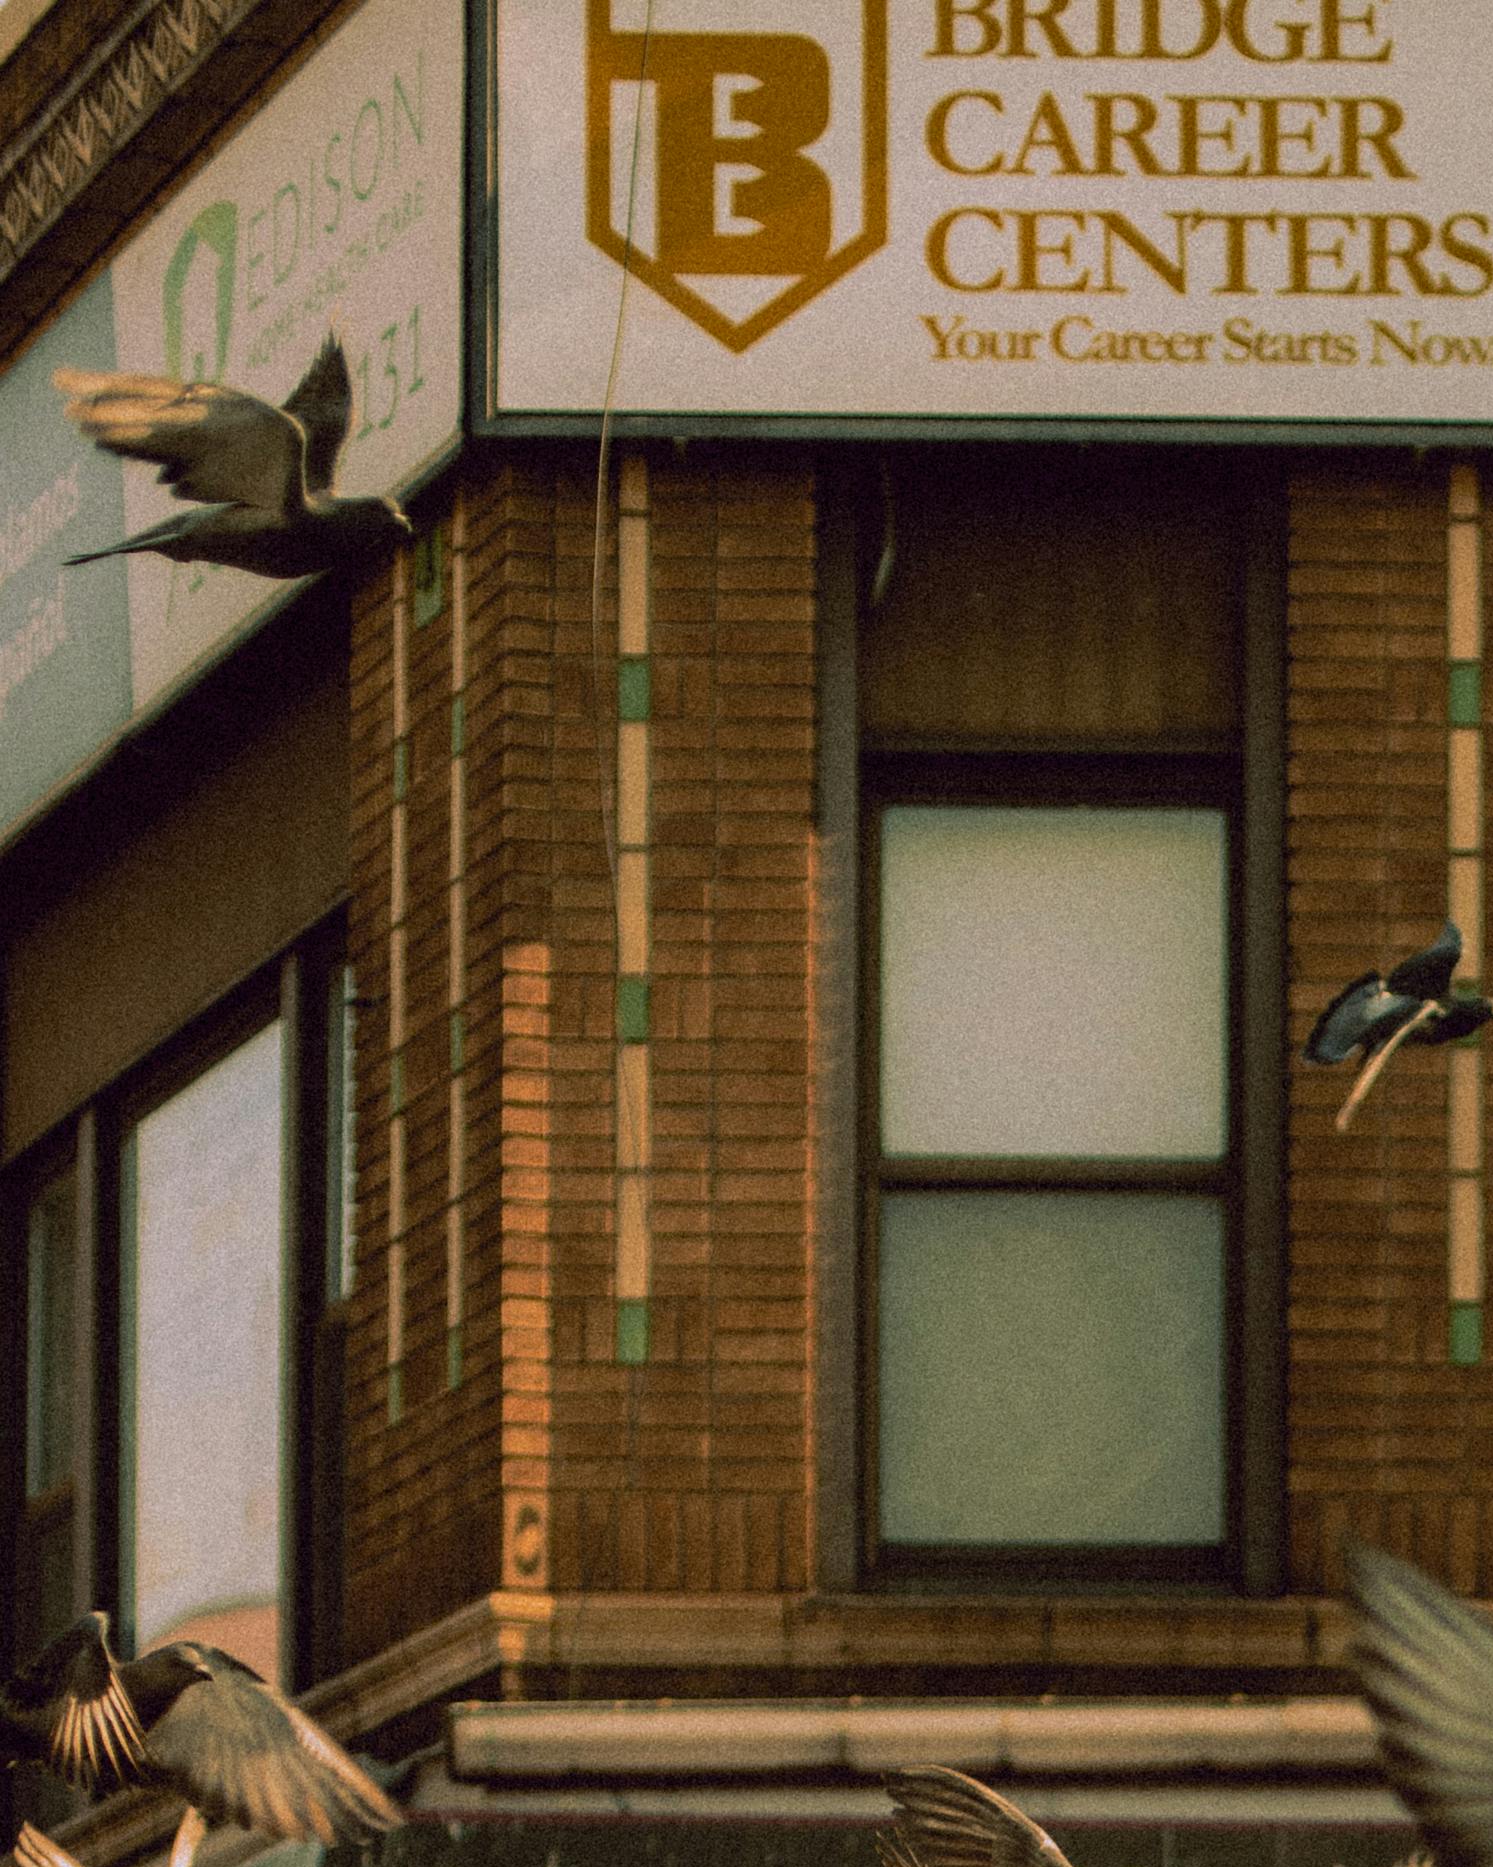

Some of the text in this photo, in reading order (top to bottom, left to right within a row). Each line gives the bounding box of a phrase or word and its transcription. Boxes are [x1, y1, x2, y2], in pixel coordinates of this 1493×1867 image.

[926, 0, 1393, 64] BRIDGE
[925, 90, 1416, 180] CAREER
[247, 50, 426, 312] EDISON
[920, 315, 1043, 364] Your
[1049, 315, 1215, 365] Career
[1223, 316, 1359, 366] Starts
